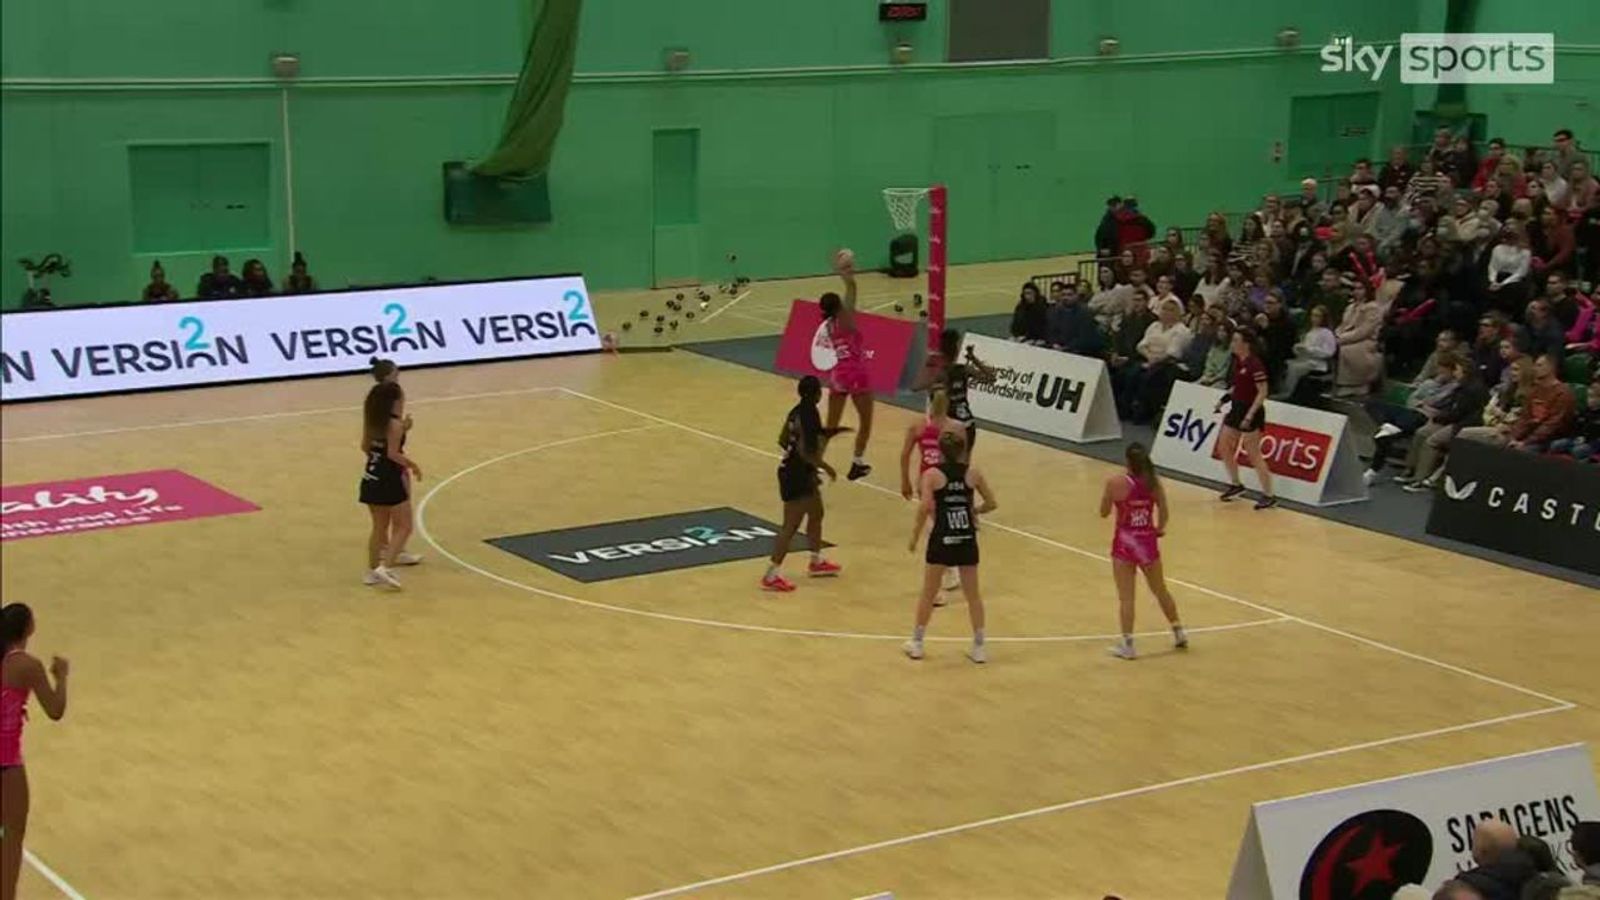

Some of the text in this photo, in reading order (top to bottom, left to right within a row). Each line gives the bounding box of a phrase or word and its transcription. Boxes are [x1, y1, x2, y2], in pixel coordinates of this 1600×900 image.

[968, 379, 1034, 403] ertfordshire
[1020, 371, 1035, 385] of
[1036, 373, 1086, 413] UH
[1164, 408, 1217, 452] sky
[1447, 795, 1580, 854] SACENS
